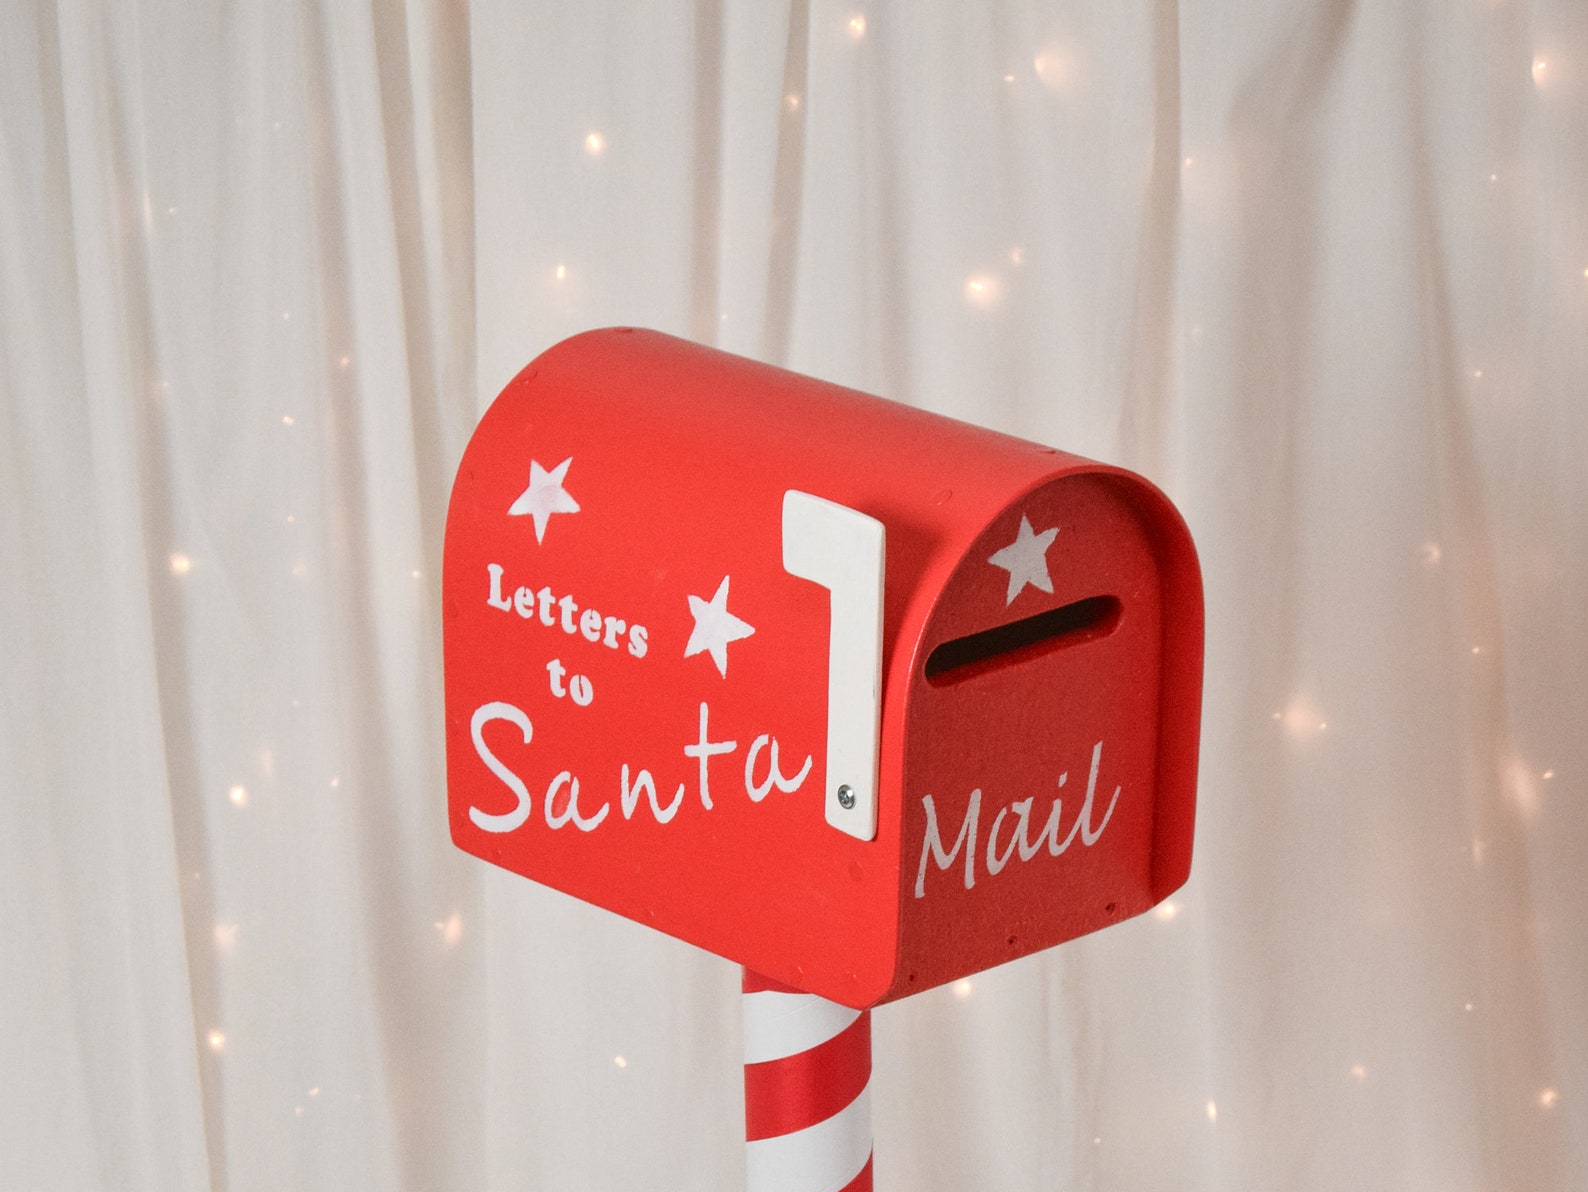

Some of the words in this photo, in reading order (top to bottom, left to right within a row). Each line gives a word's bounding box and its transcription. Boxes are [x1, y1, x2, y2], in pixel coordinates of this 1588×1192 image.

[486, 562, 649, 659] Letters
[545, 657, 595, 708] to
[468, 700, 813, 834] Santa
[914, 740, 1122, 899] Mail
